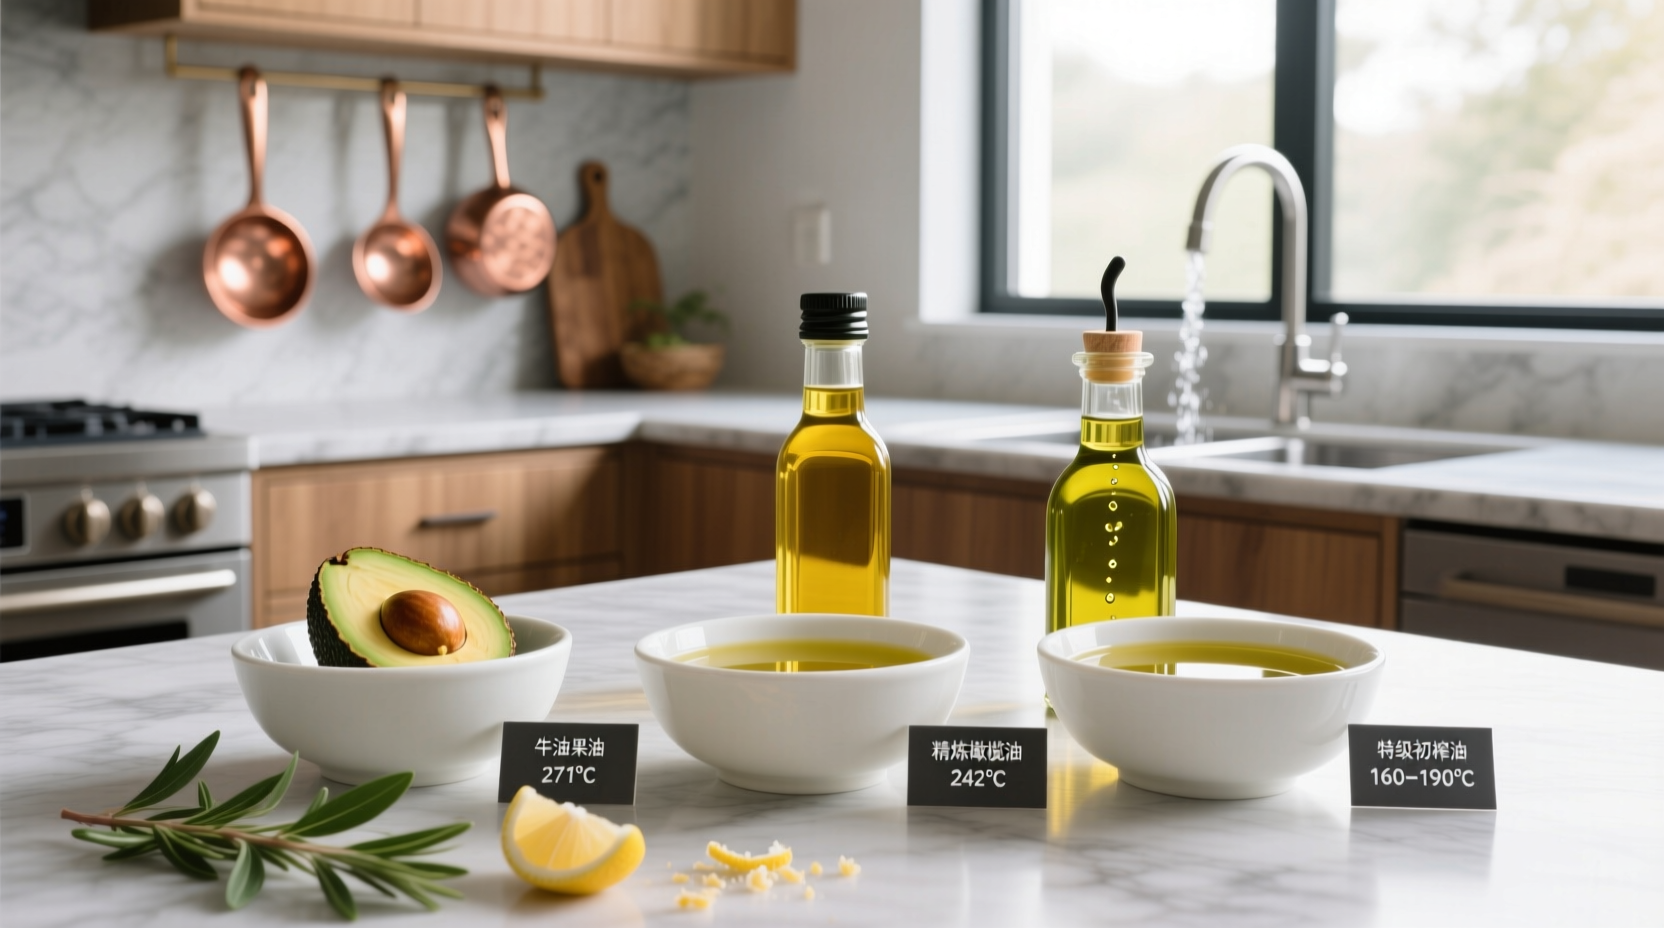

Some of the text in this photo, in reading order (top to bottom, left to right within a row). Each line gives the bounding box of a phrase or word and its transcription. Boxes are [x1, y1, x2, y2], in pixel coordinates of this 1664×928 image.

[534, 736, 605, 757] 牛油果油
[541, 765, 596, 784] 271°C
[950, 768, 1006, 788] 242°C
